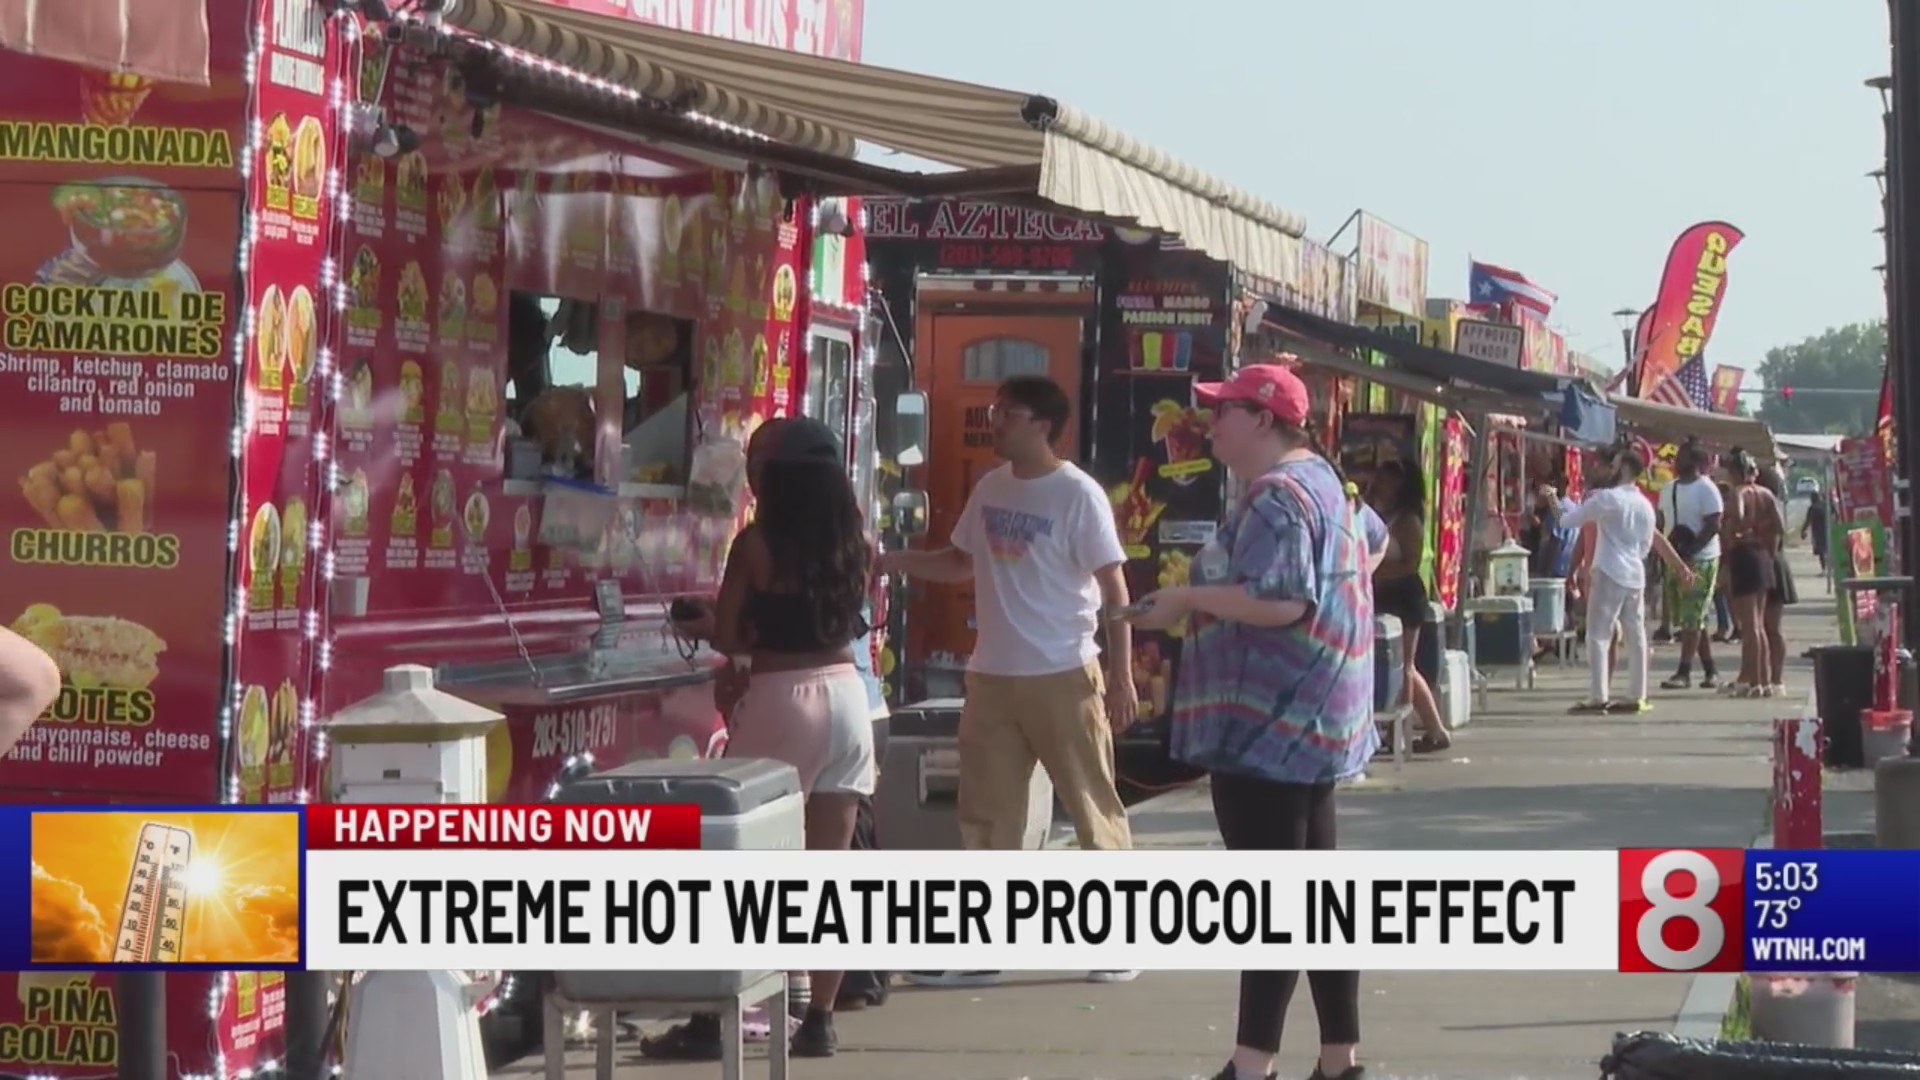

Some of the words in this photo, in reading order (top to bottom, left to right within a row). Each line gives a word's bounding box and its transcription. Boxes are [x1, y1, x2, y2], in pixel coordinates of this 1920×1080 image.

[0, 121, 233, 167] MANGONADA
[865, 201, 918, 237] EL
[927, 201, 1104, 240] AZTECA
[3, 284, 169, 321] COCKTAIL
[180, 293, 225, 325] DE
[5, 319, 220, 356] CAMARONES
[1463, 324, 1518, 344] APPROVED
[0, 353, 66, 376] Shrimp,
[73, 356, 149, 379] ketchup,
[157, 359, 228, 381] clamato
[1469, 343, 1509, 359] VENDOR
[28, 373, 101, 396] cilantro,
[110, 377, 138, 395] red
[145, 378, 195, 397] onion
[60, 395, 92, 412] and
[99, 395, 161, 415] tomato
[11, 528, 180, 568] CHURROS
[38, 684, 155, 726] OTES
[48, 743, 88, 762] chili
[95, 746, 163, 767] powder
[145, 729, 210, 750] cheese
[25, 980, 117, 1026] PIÑA
